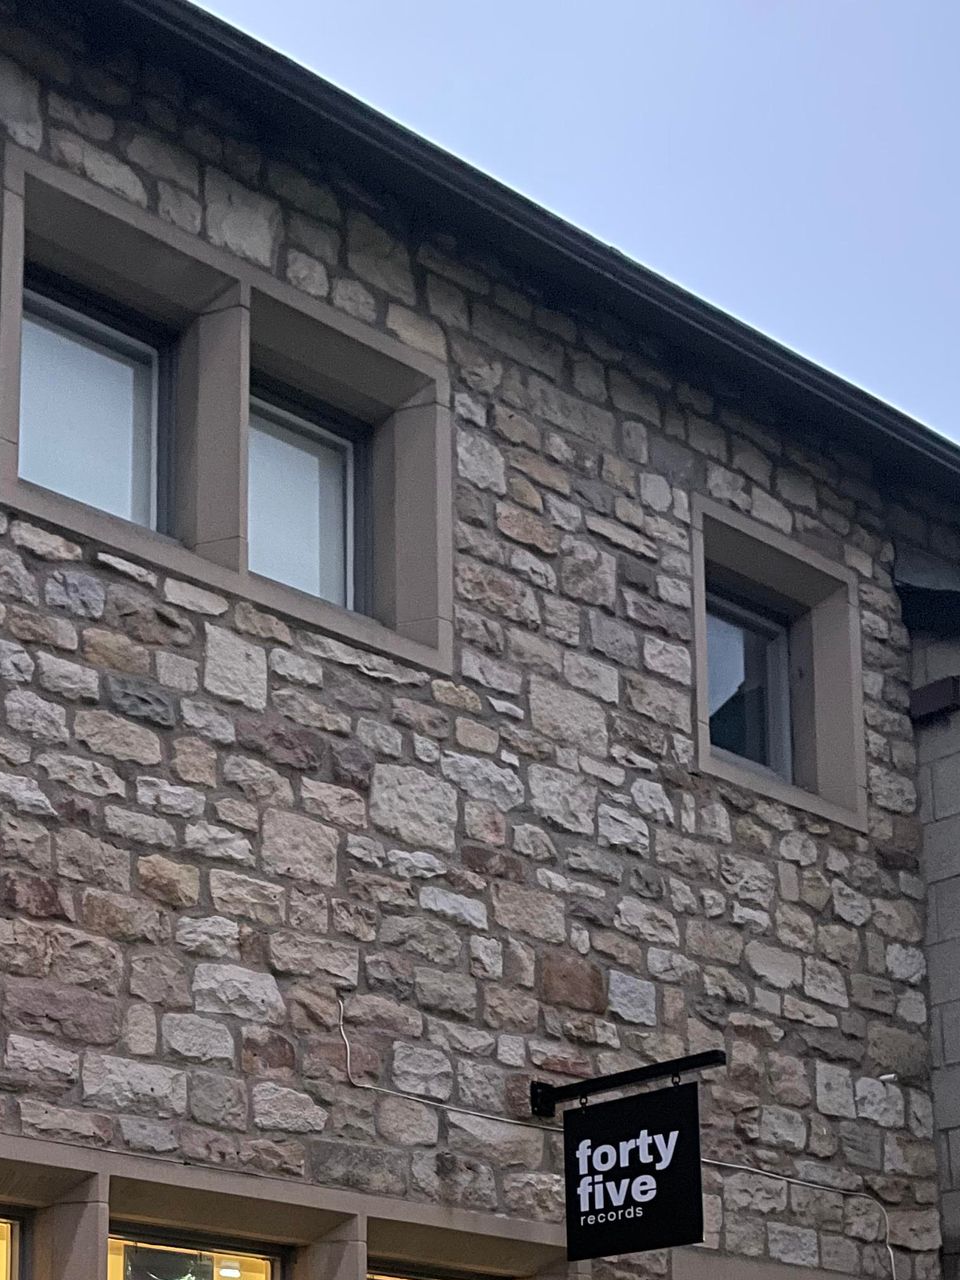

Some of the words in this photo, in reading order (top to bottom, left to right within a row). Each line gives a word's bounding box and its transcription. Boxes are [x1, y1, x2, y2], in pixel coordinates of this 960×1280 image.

[576, 1129, 679, 1175] forty
[577, 1174, 657, 1212] five
[580, 1206, 643, 1226] records
